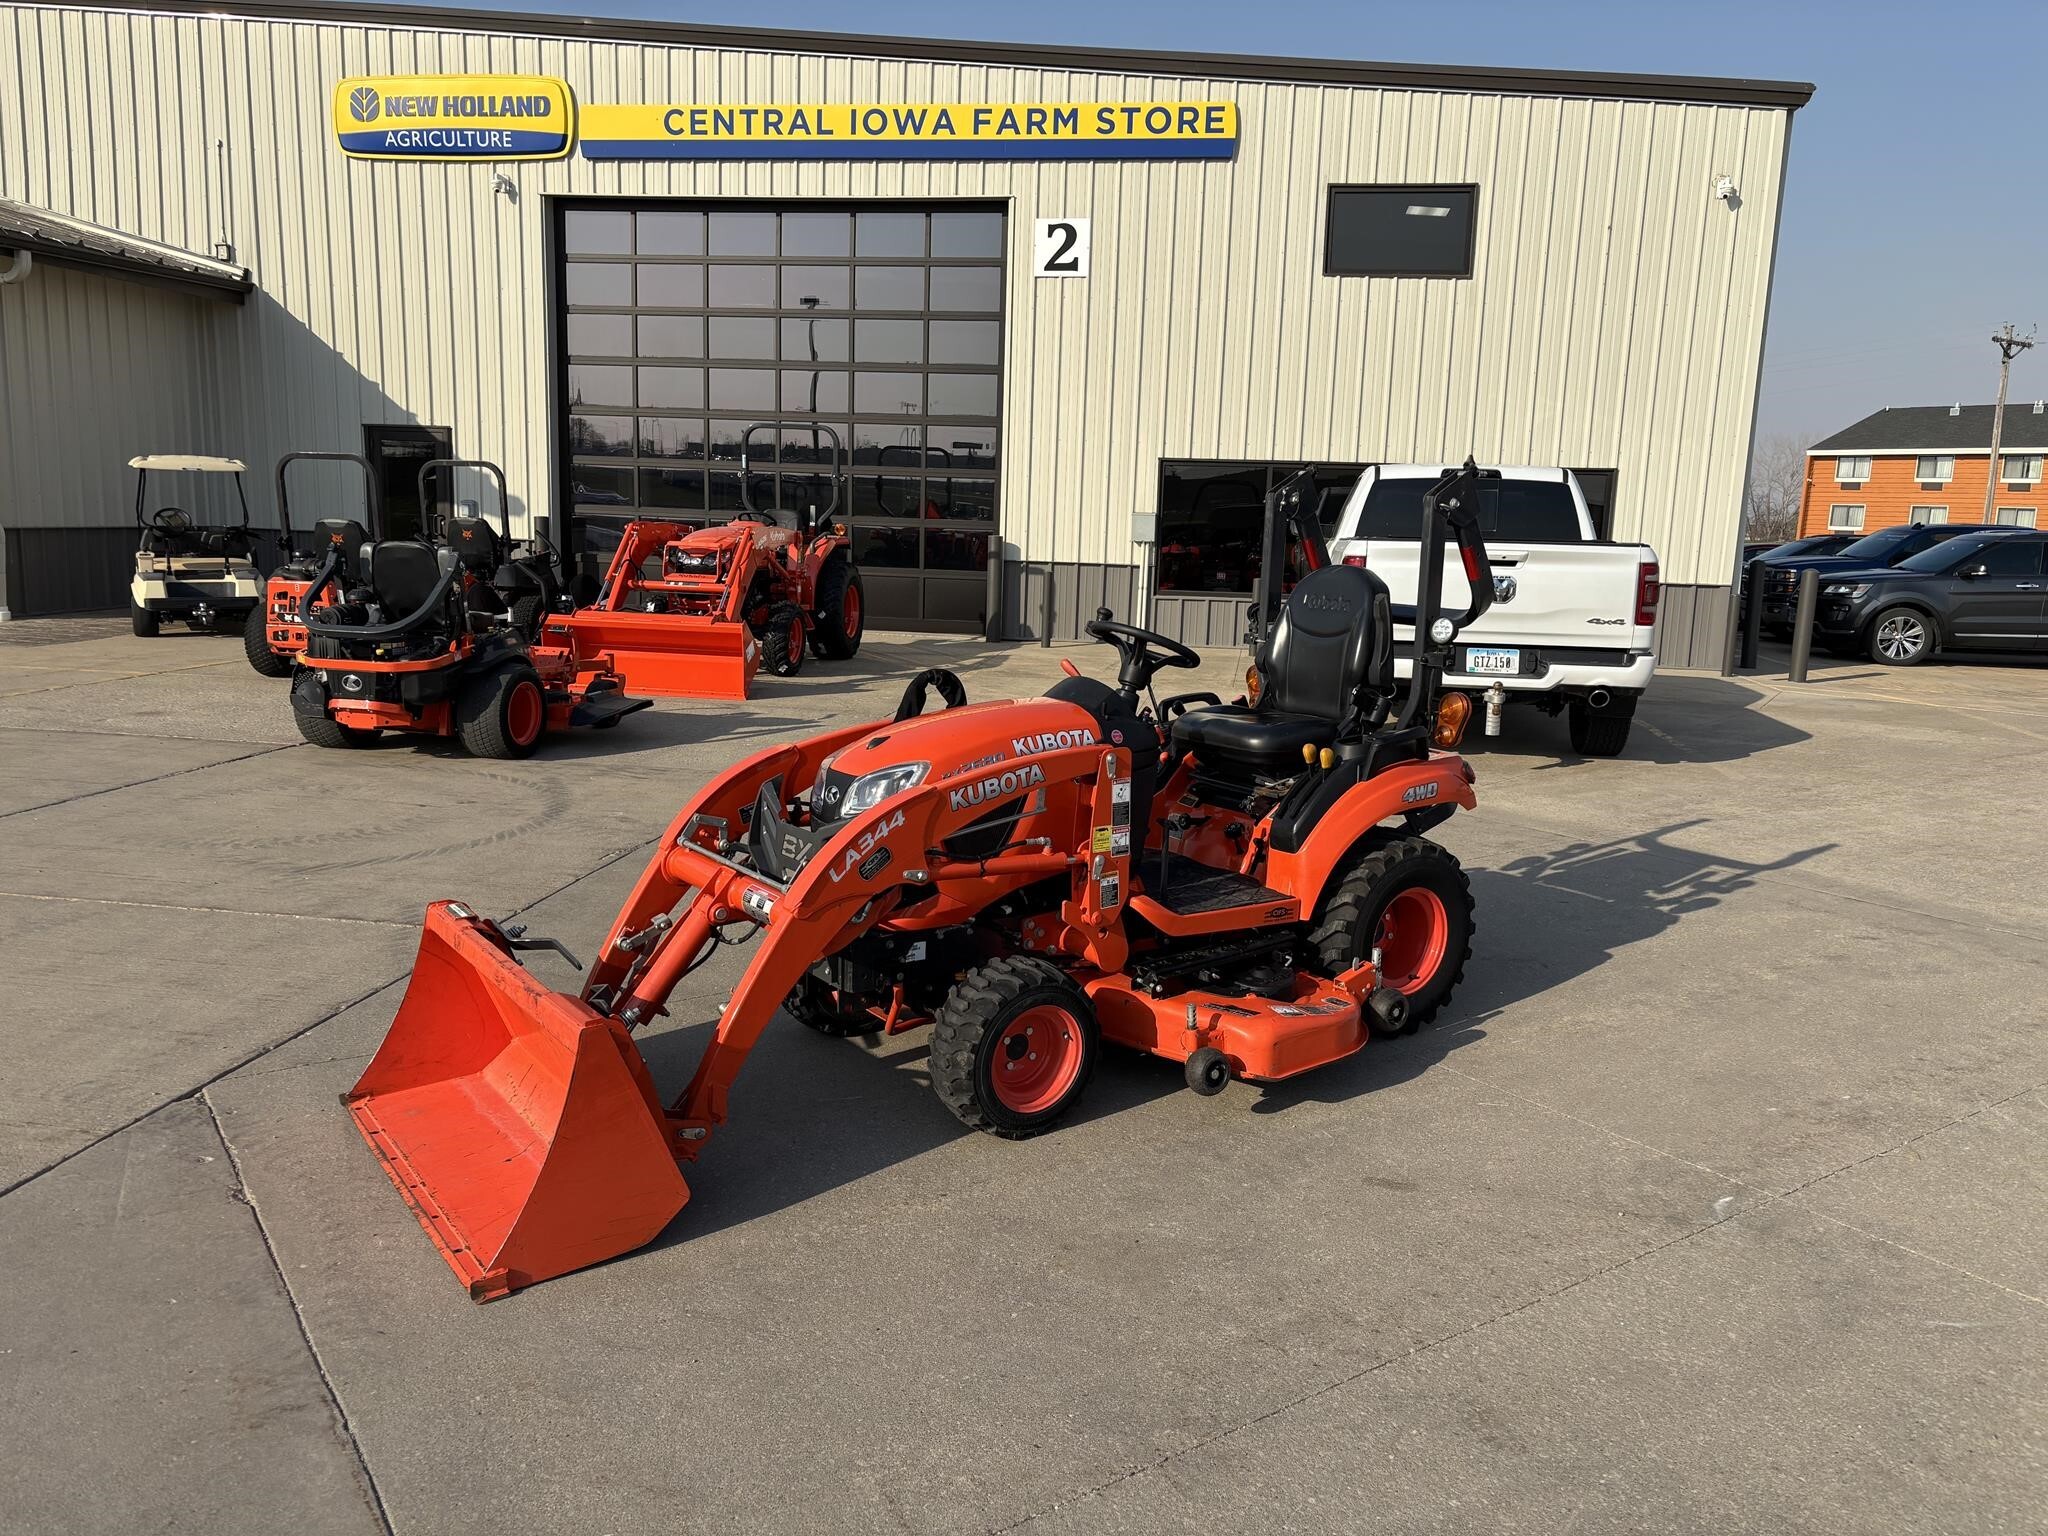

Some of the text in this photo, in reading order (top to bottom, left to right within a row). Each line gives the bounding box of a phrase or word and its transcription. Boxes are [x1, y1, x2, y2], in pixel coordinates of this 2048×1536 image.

[384, 95, 551, 118] NEW HOLLAND
[663, 105, 1226, 136] CENTRAL IOWA FARM STORE
[385, 130, 512, 148] AGRICULTURE
[1043, 222, 1079, 272] 2
[1012, 728, 1096, 757] KUBOTA
[949, 762, 1046, 812] KUBOTA
[1402, 781, 1439, 803] 4WD
[828, 809, 907, 883] LA344
